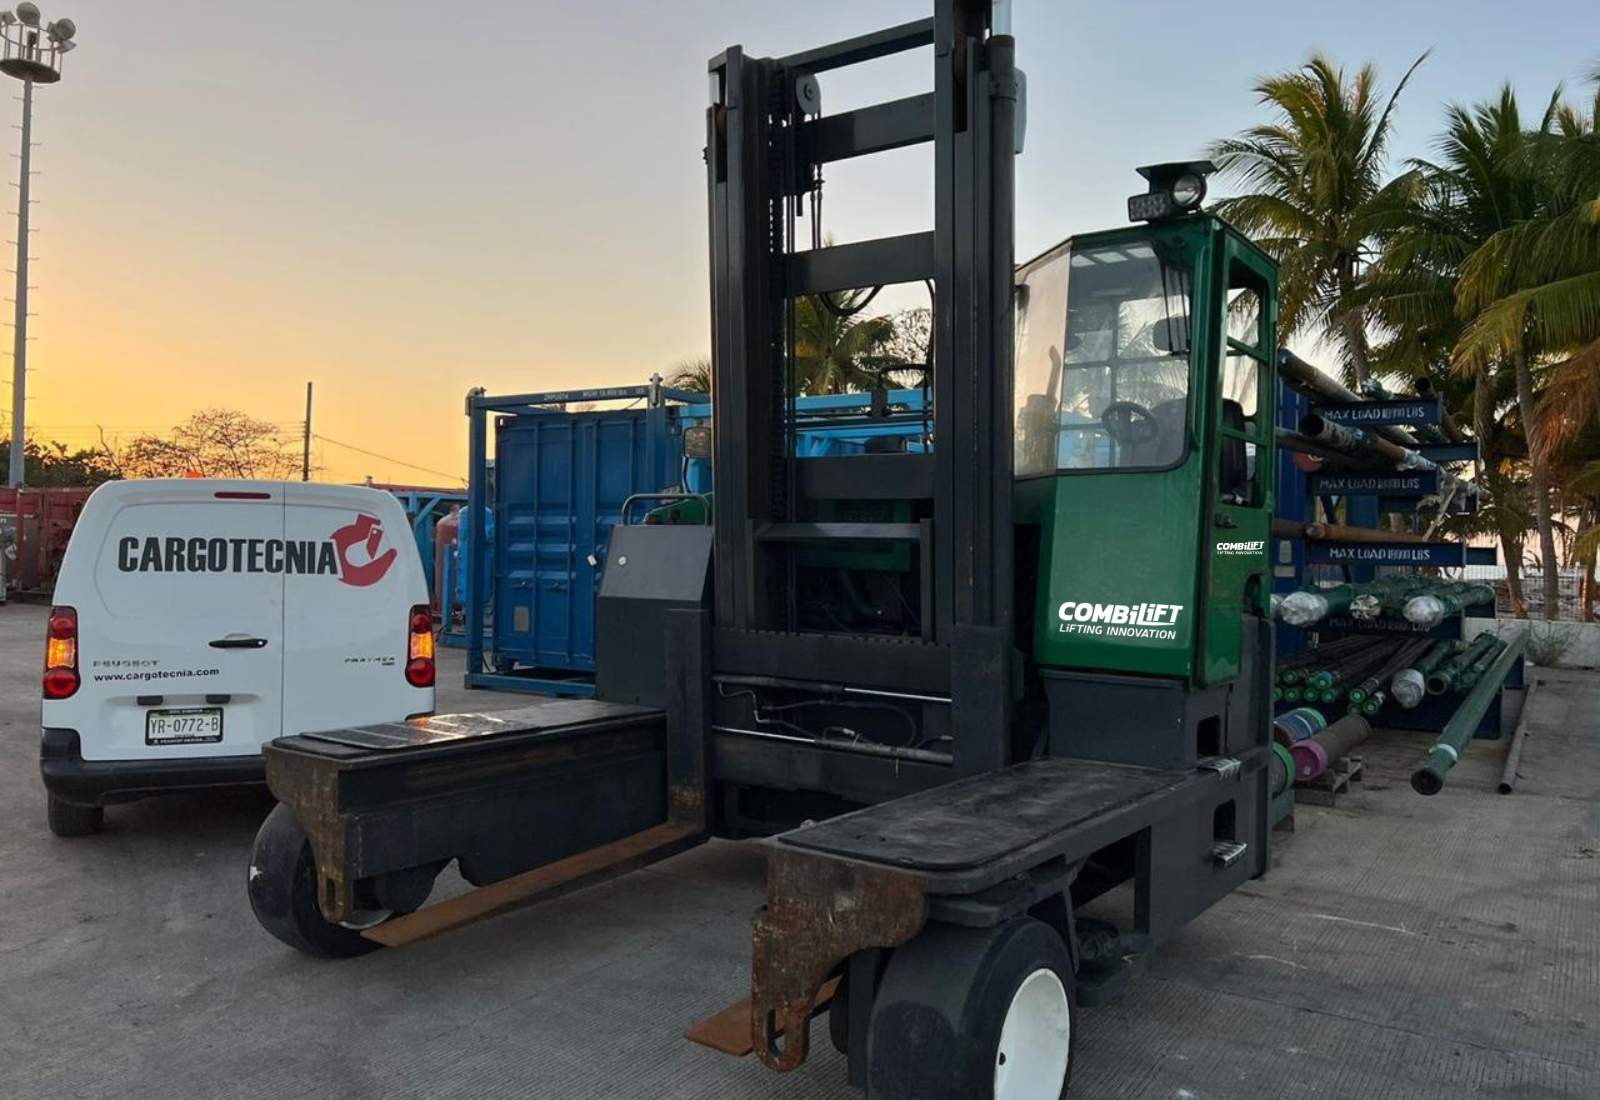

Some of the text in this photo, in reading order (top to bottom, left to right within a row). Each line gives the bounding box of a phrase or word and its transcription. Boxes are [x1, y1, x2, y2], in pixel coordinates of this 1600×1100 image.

[1324, 409, 1350, 420] MAX
[1352, 408, 1381, 420] LOAD
[1320, 478, 1345, 490] MAX
[118, 536, 339, 575] CARGOTECNIA
[1329, 548, 1355, 559] MAX
[1357, 548, 1386, 560] LOAD
[1106, 626, 1177, 640] INNOVATION
[94, 669, 220, 681] www.cargotecnia.com
[150, 716, 219, 735] YR-0772-B
